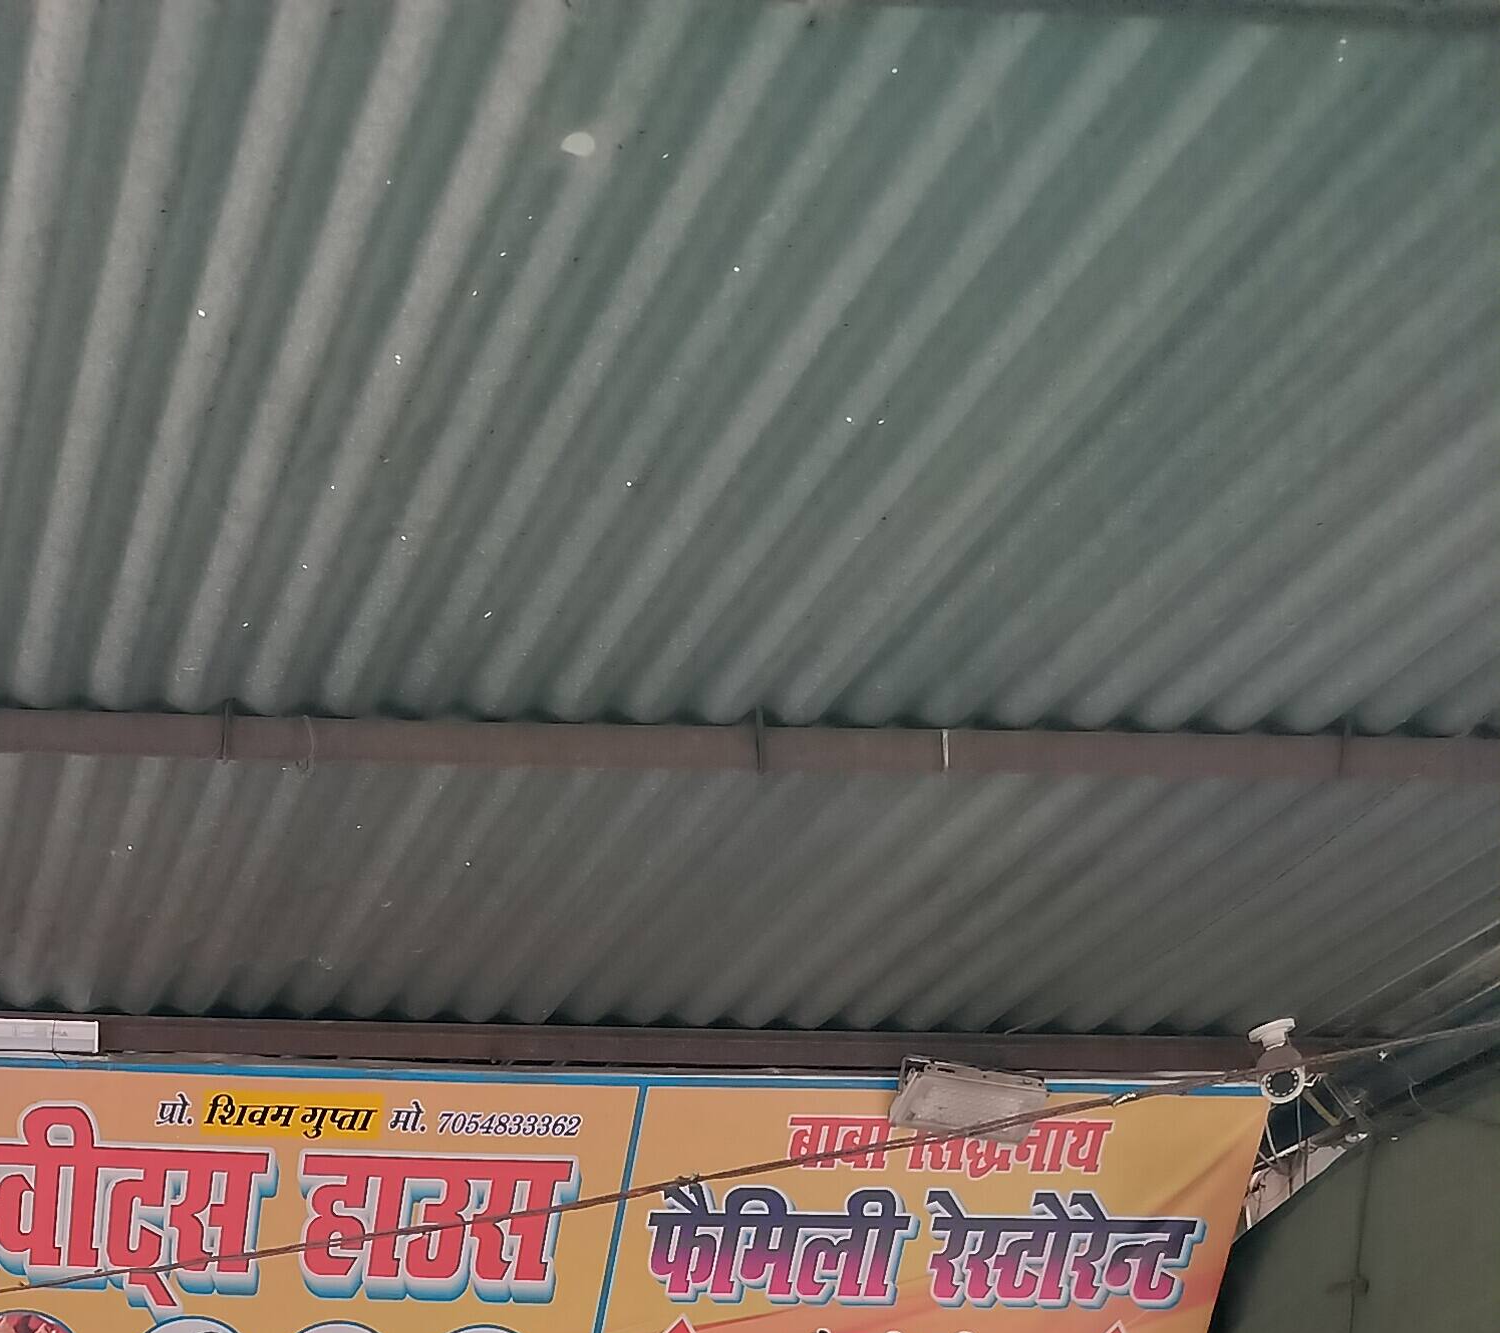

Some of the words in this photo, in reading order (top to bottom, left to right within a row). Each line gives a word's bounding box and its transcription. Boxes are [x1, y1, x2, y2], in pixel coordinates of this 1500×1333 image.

[204, 1094, 299, 1127] शिवम
[300, 1106, 378, 1139] गुप्ता
[389, 1101, 427, 1132] मो.
[438, 1112, 582, 1138] 7054833362
[300, 1149, 582, 1304] हाउस
[647, 1183, 918, 1306] फैमिली
